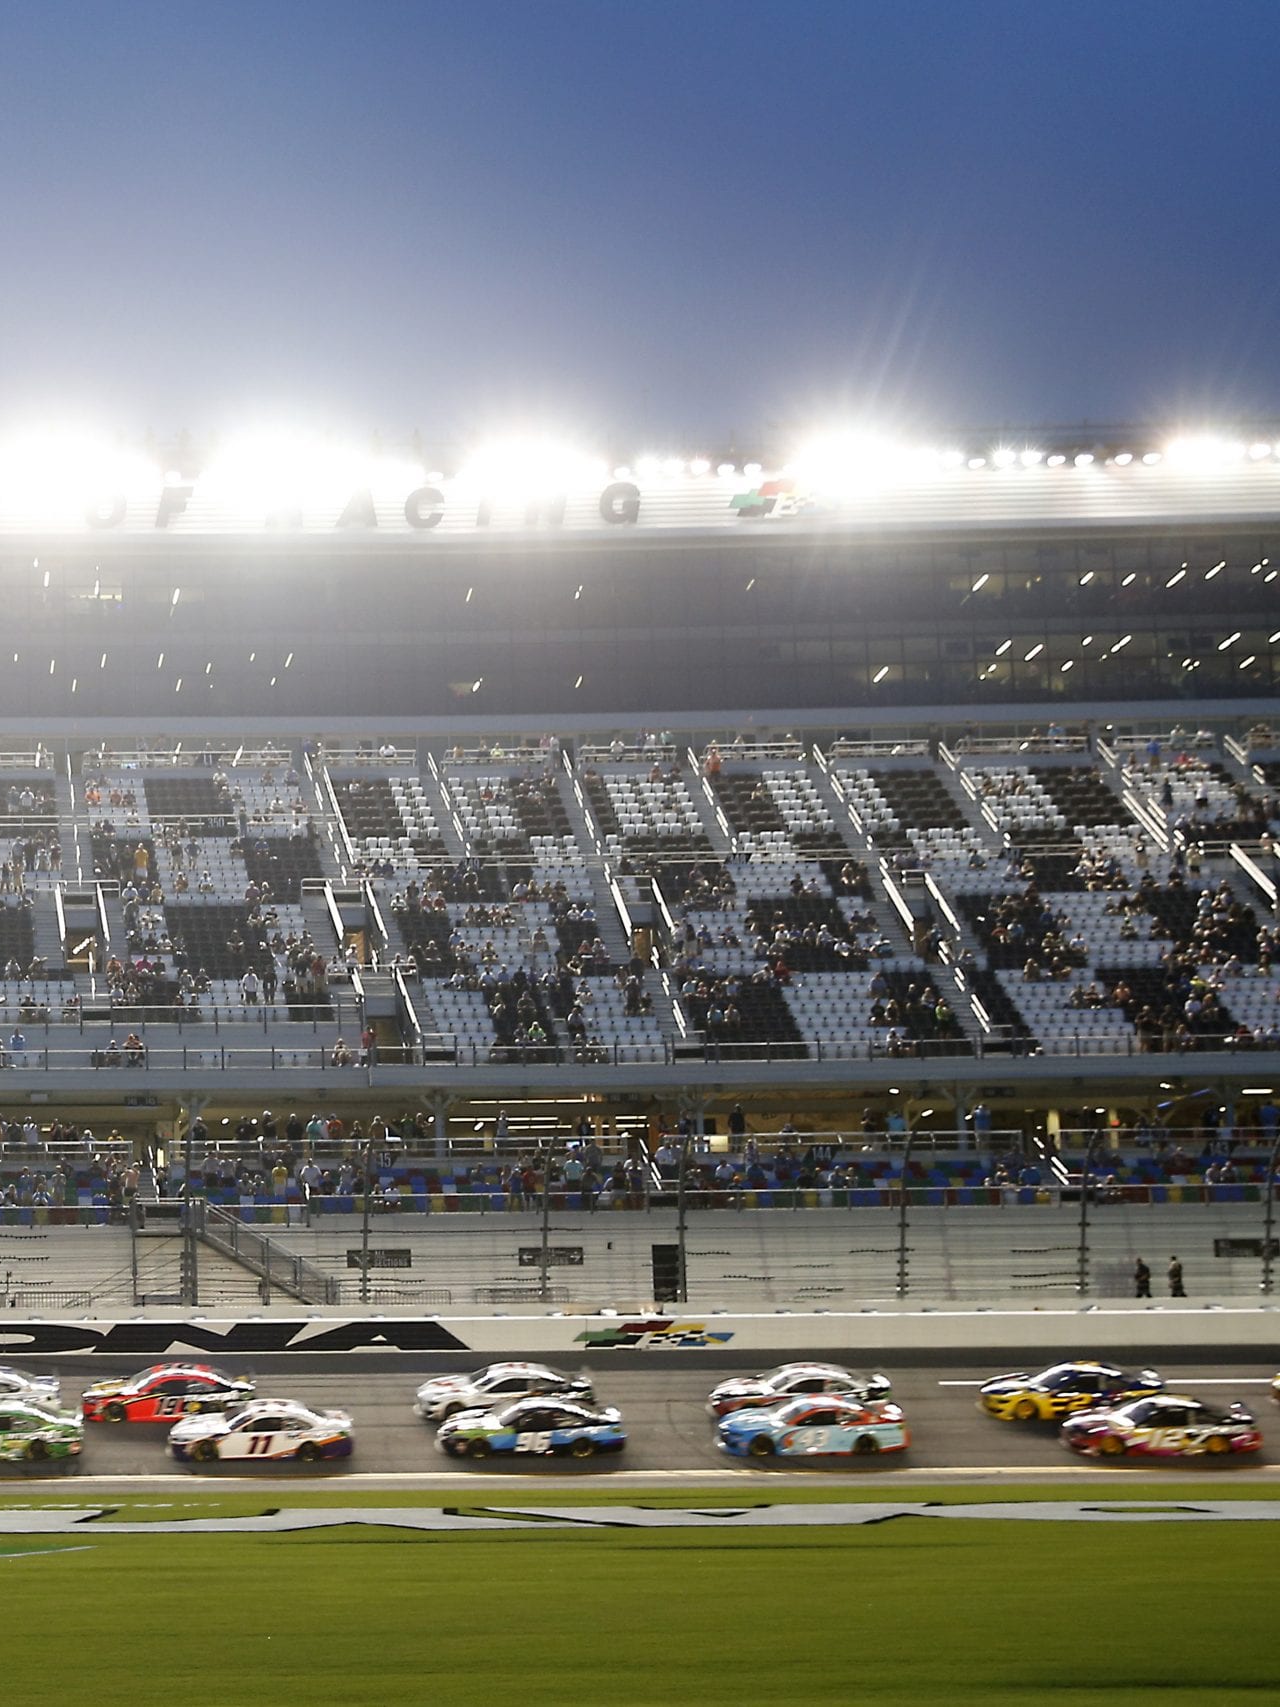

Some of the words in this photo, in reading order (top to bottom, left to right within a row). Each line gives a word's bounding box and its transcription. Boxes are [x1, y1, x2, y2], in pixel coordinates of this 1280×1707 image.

[812, 1145, 831, 1161] 144
[246, 1435, 274, 1455] 11
[799, 1428, 832, 1448] 43
